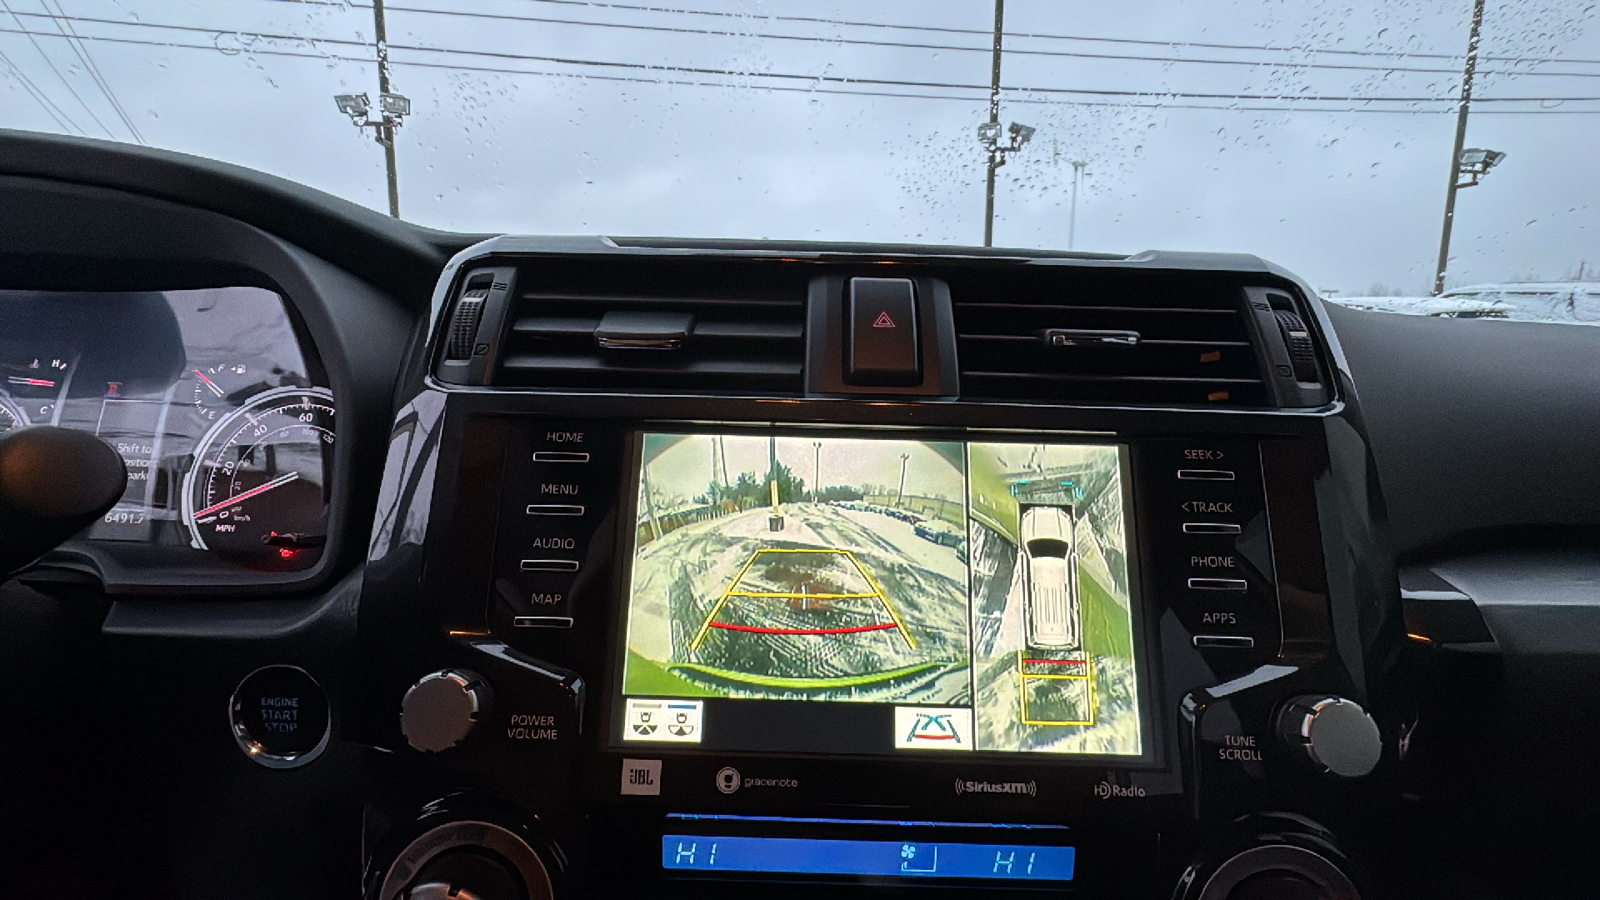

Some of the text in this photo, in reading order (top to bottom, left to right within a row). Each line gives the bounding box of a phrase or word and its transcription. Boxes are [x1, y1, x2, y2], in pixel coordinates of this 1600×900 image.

[298, 412, 314, 423] 60
[253, 424, 268, 438] 40
[546, 432, 584, 443] HOME
[117, 442, 152, 454] Shift to
[1184, 449, 1212, 460] SEEK
[221, 461, 235, 476] 20
[540, 483, 579, 494] MENU
[1191, 501, 1233, 513] TRACK
[215, 524, 236, 533] MPH
[532, 537, 575, 549] AUDIO
[1190, 555, 1235, 568] PHONE
[531, 593, 562, 605] MAP
[1202, 612, 1236, 624] APPS
[261, 697, 299, 707] ENGINE
[261, 709, 298, 720] START
[510, 714, 555, 727] POWER
[264, 722, 298, 732] STOP
[507, 728, 558, 740] VOLUME
[1224, 735, 1255, 747] TUNE
[1219, 748, 1262, 761] SCROLL
[629, 768, 654, 786] JBL
[744, 777, 798, 788] gracenote
[1112, 784, 1146, 797] Radio
